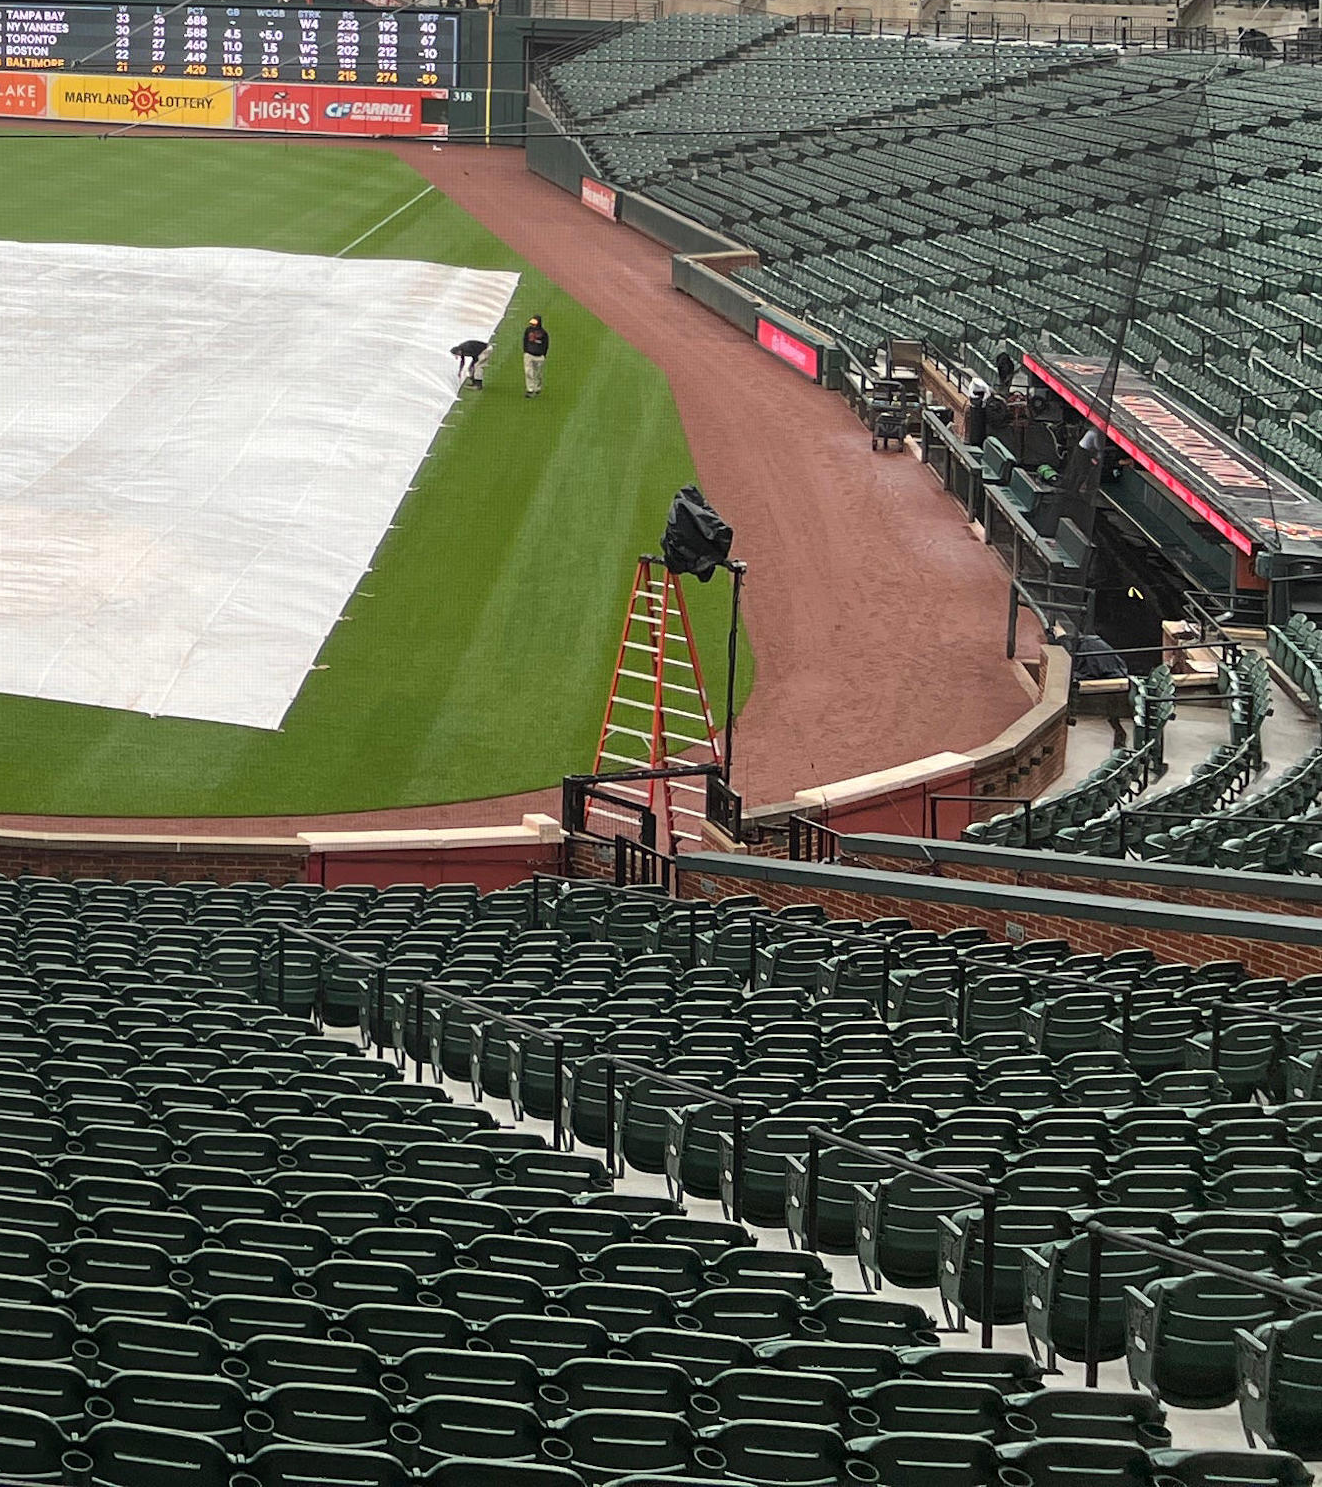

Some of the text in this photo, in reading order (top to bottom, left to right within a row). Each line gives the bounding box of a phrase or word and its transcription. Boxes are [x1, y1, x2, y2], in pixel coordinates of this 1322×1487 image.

[6, 9, 41, 21] TAMPA
[42, 11, 66, 21] BAY
[116, 13, 129, 24] 33
[299, 19, 319, 29] W4
[337, 21, 359, 31] 232
[378, 22, 398, 32] 192
[420, 23, 436, 33] 40
[187, 7, 205, 15] PCT
[226, 8, 240, 16] GB
[257, 9, 285, 17] WCGB
[6, 22, 22, 32] NY
[22, 22, 70, 34] YANKEES
[116, 25, 129, 35] 30
[153, 27, 165, 36] 21
[224, 29, 242, 39] 4.5
[302, 31, 316, 41] L2
[378, 34, 398, 44] 183
[420, 35, 435, 46] 67
[6, 33, 57, 45] TORONTO
[116, 38, 129, 48] 23
[152, 39, 165, 49] 27
[184, 40, 207, 50] .460
[223, 41, 242, 52] 11.0
[263, 43, 278, 53] 1.5
[337, 45, 359, 55] 202
[377, 47, 397, 57] 212
[418, 48, 438, 59] -10
[6, 46, 49, 57] BOSTON
[116, 50, 129, 60] 22
[152, 51, 165, 61] 27
[183, 53, 207, 63] .449
[223, 54, 242, 64] 11.5
[261, 55, 279, 65] 2.0
[5, 57, 65, 69] BALTIMORE
[183, 65, 207, 75] .420
[221, 66, 244, 77] 13.0
[301, 69, 316, 80] L3
[337, 71, 357, 81] 215
[376, 72, 398, 83] 274
[416, 74, 438, 85] -59
[65, 91, 214, 110] MARYLAND LOTTERY
[453, 91, 473, 102] 318
[249, 101, 310, 124] HIGH'S
[351, 101, 412, 117] CARROLL
